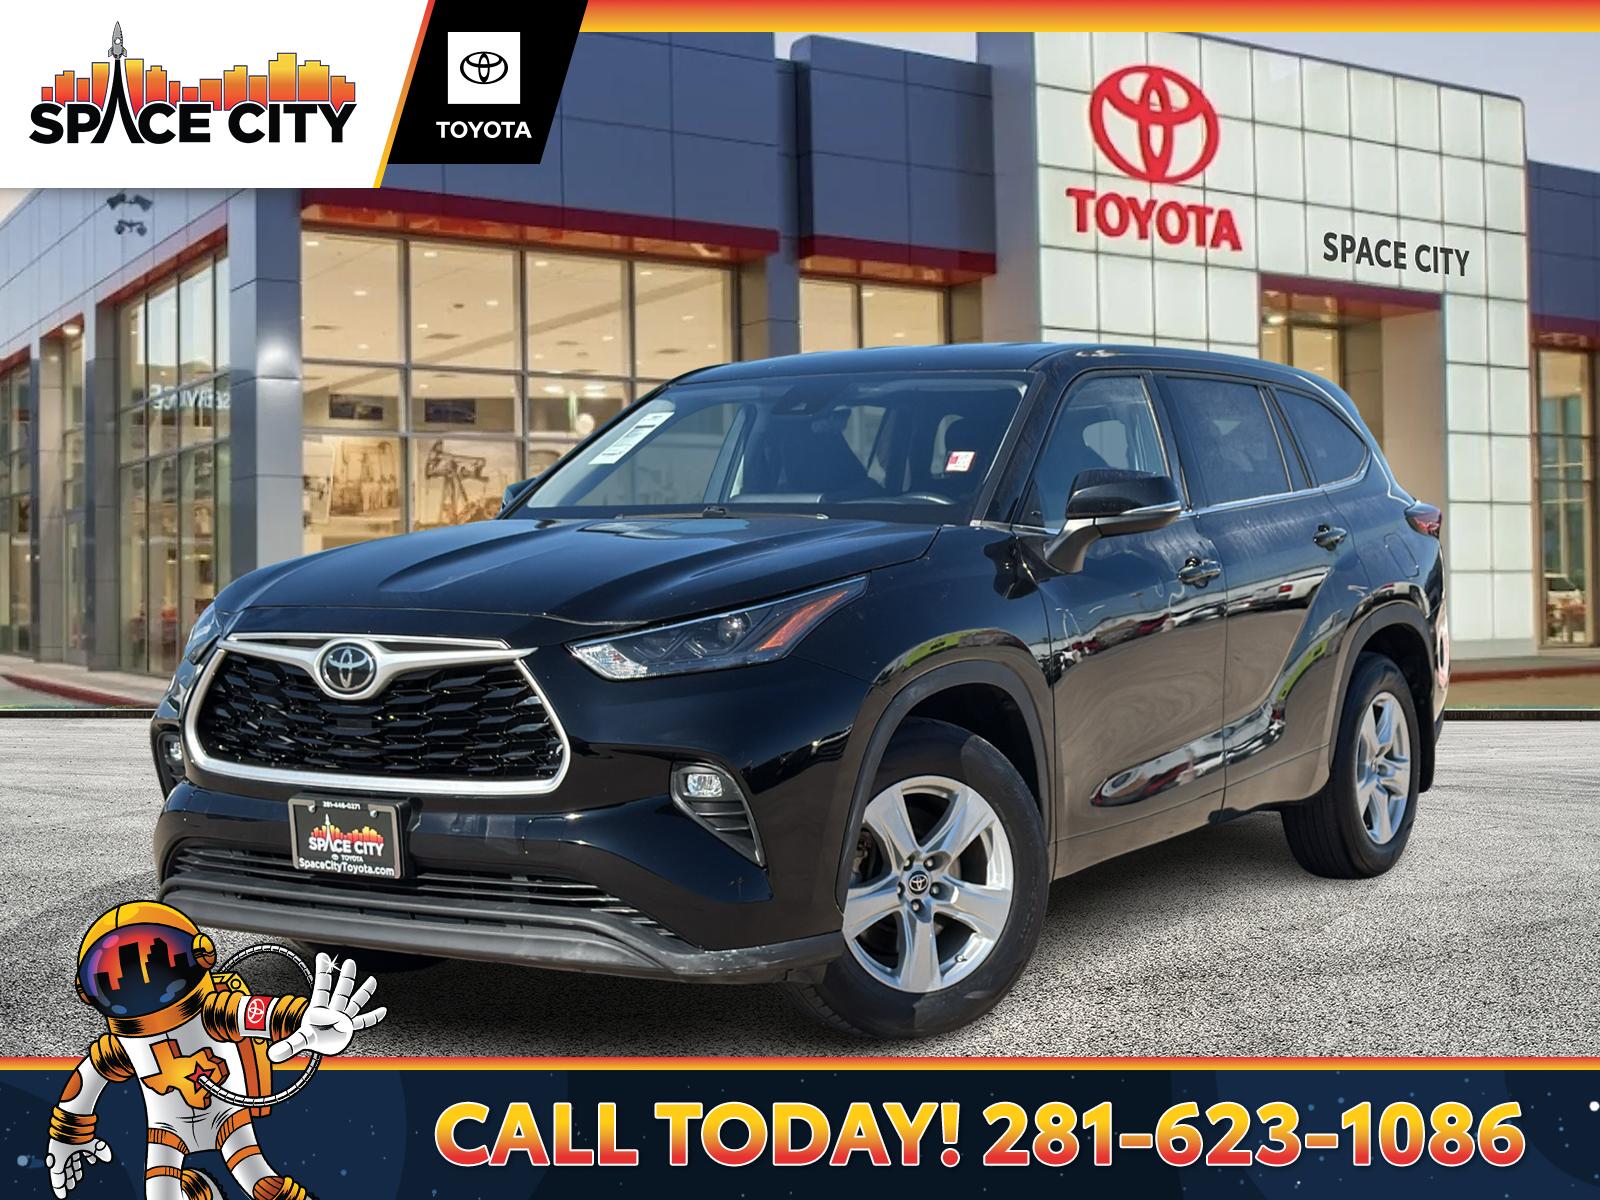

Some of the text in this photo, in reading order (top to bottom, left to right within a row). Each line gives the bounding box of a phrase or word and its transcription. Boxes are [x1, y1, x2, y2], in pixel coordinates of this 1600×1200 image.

[1066, 187, 1243, 252] TOYOTA
[1323, 232, 1470, 277] SPACE CITY
[308, 826, 384, 856] SPACE CITY
[298, 857, 394, 876] SpaceCityToyota.com
